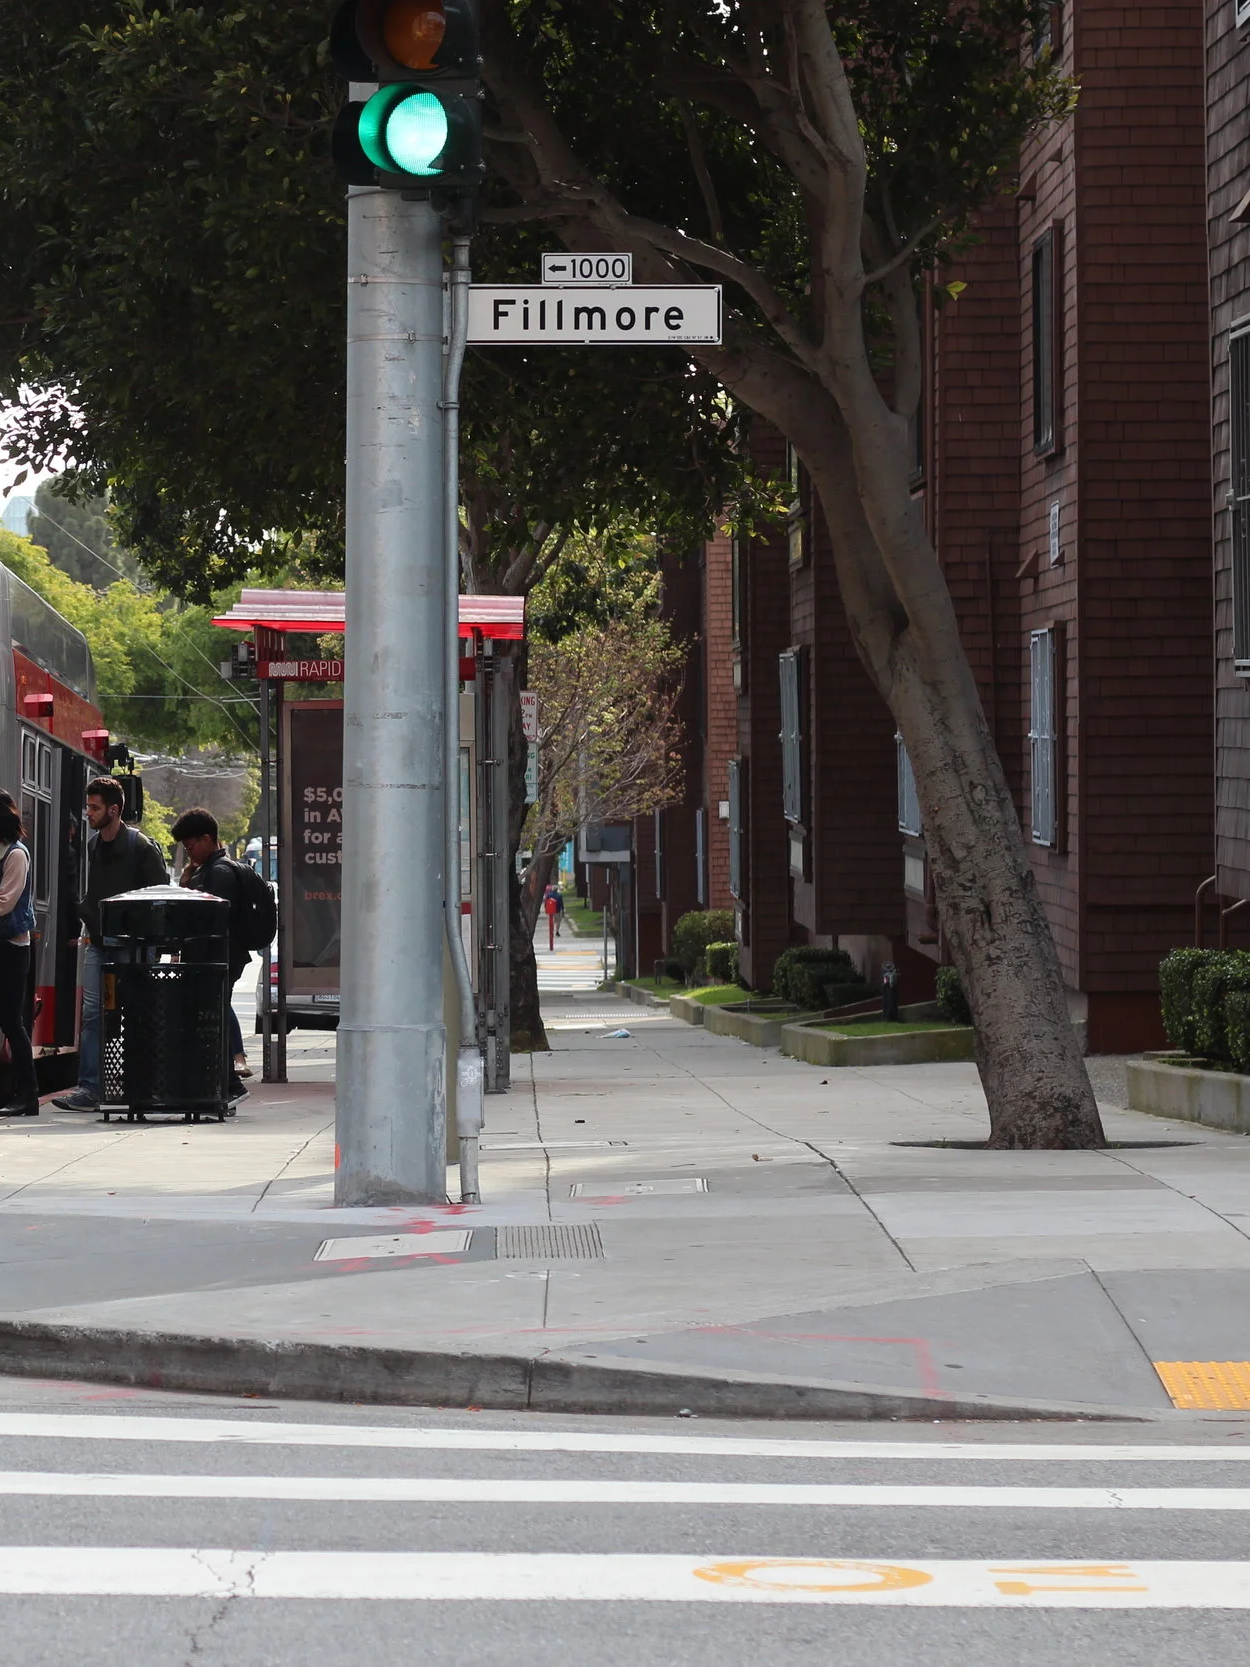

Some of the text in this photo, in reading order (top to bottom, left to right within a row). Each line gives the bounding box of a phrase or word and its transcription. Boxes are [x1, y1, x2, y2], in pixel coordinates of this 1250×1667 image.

[570, 258, 626, 279] 1000
[493, 299, 684, 331] Fillmore
[300, 661, 342, 677] RAPID
[304, 808, 321, 822] in
[303, 829, 331, 844] for
